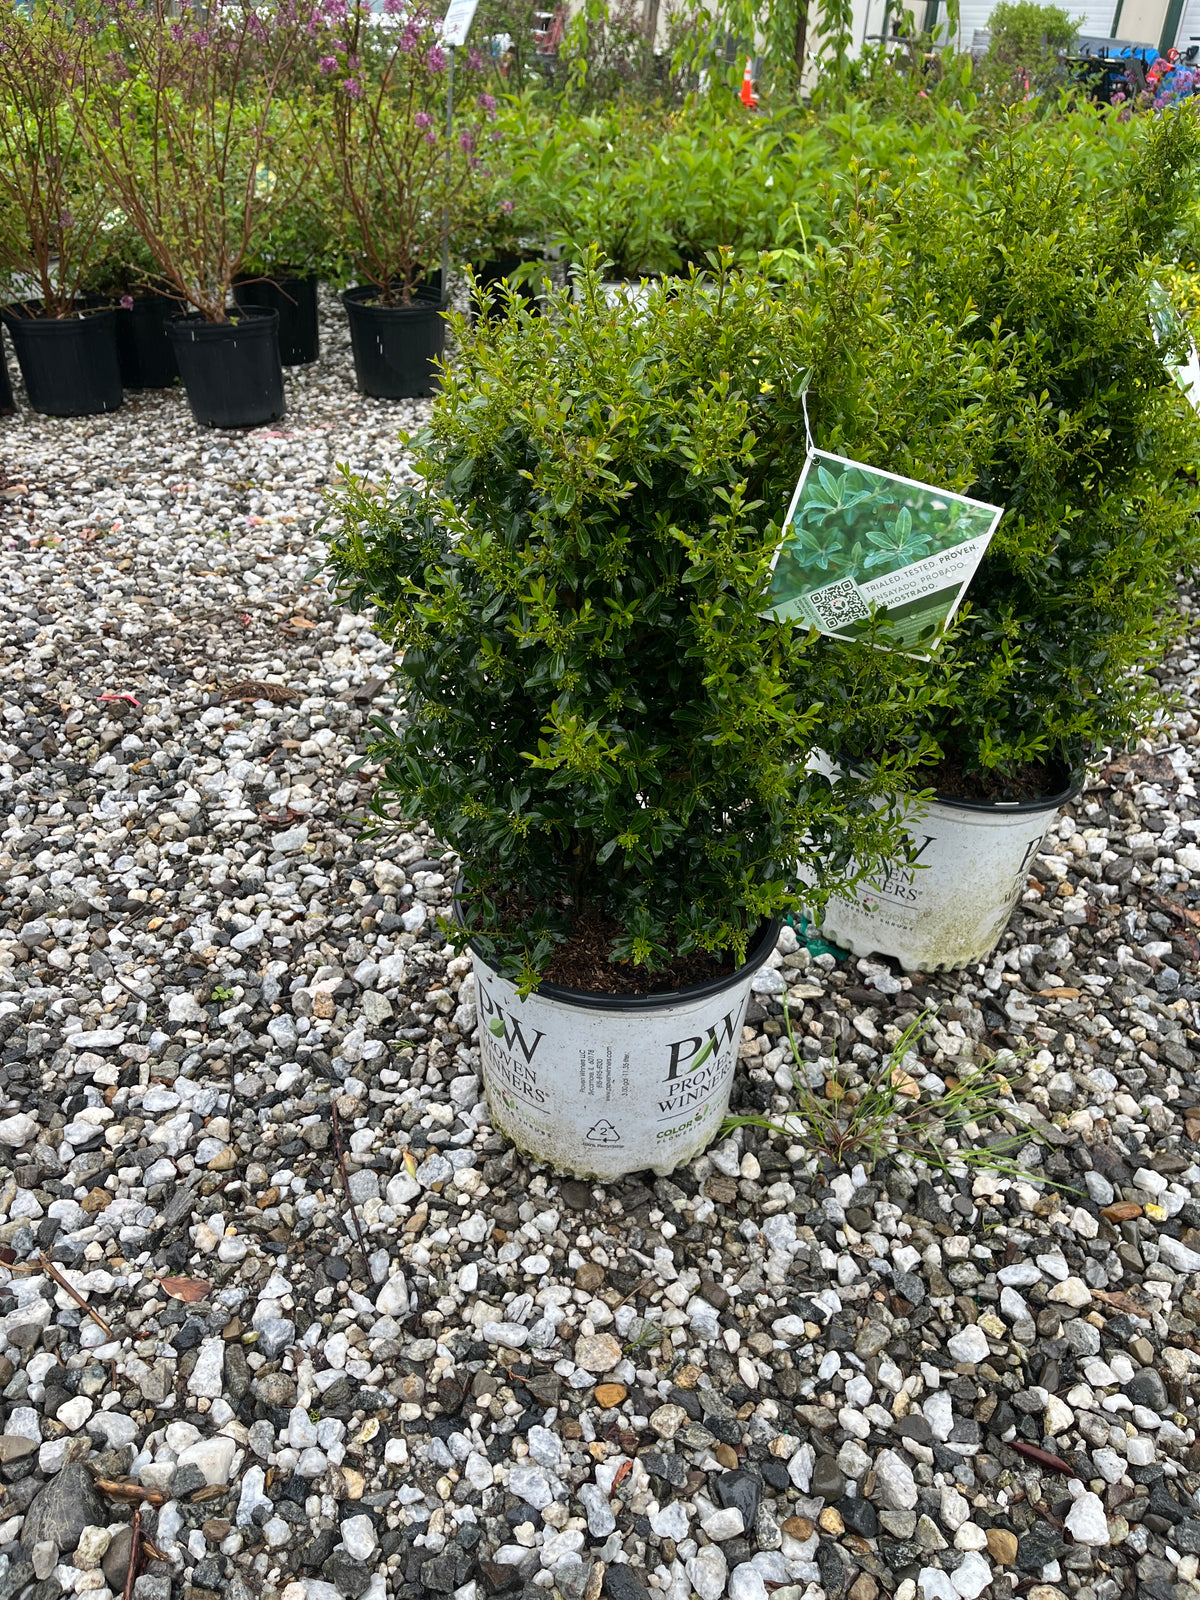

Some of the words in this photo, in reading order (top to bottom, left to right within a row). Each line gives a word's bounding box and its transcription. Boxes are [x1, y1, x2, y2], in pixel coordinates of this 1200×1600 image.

[865, 575, 904, 593] TRIALED.
[904, 561, 938, 578] TESTED.
[939, 544, 979, 564] PROVEN.
[871, 581, 919, 602] ENSAYADO.
[920, 562, 967, 584] PROBADO.
[876, 583, 938, 609] DEMOSTRADO.
[662, 994, 747, 1083] PW
[668, 1050, 734, 1097] PROVEN
[600, 1127, 608, 1136] 2
[656, 1120, 693, 1139] COLOR
